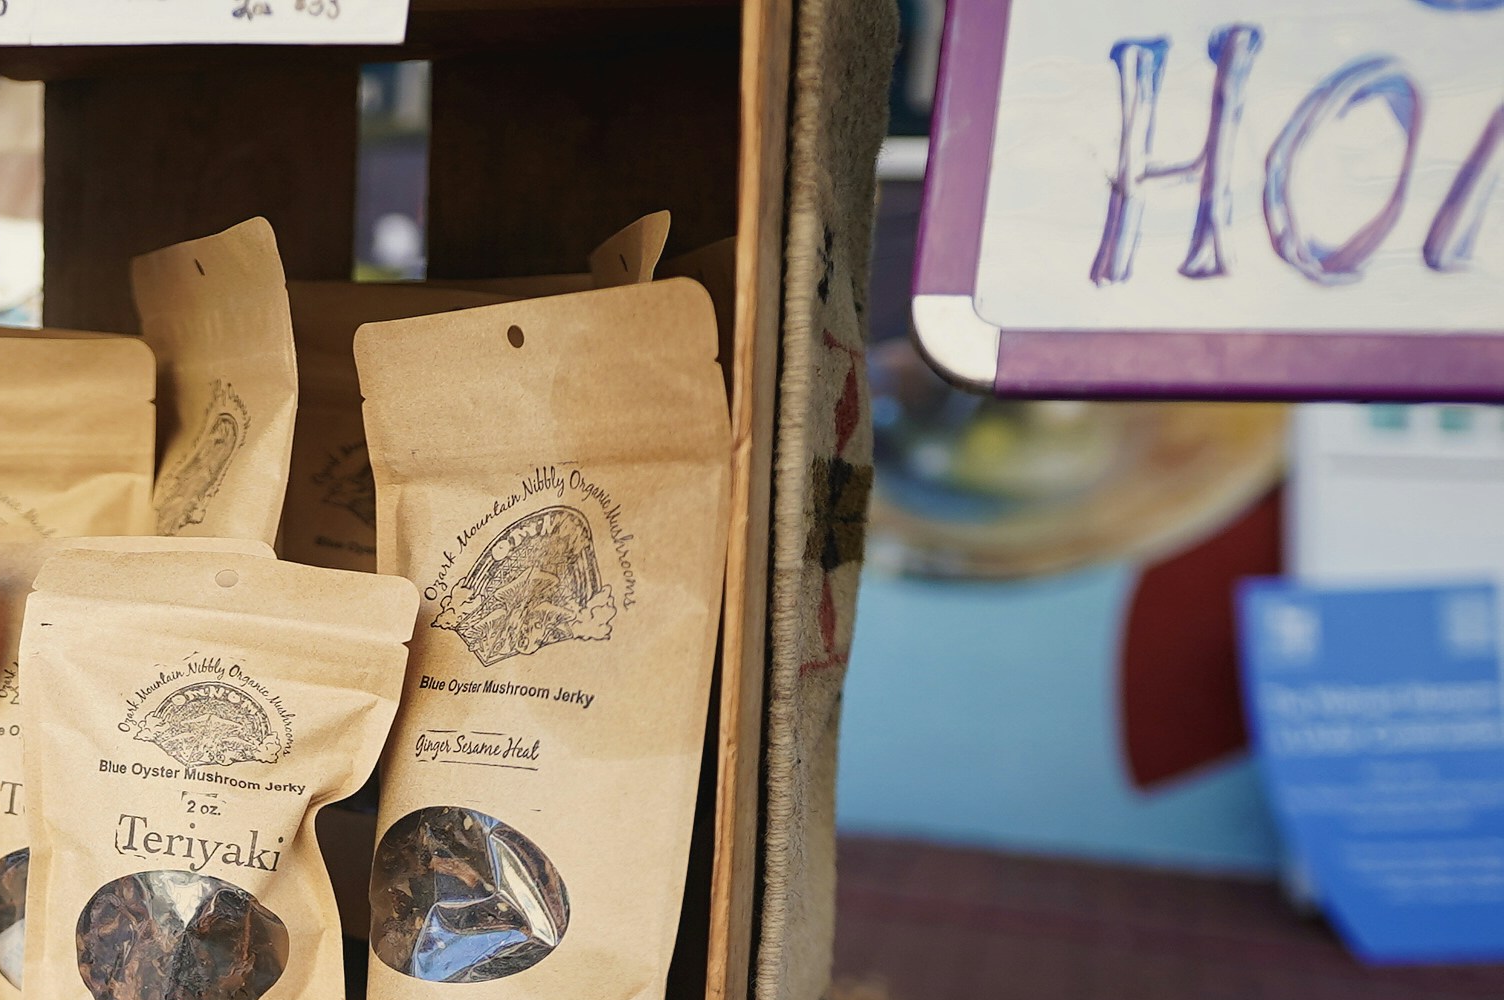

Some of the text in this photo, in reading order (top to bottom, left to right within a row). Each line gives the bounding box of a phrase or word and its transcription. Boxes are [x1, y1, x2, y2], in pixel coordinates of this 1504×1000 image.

[423, 465, 637, 611] Ozark Mountain Nibbly Organic Mushrooms
[117, 657, 296, 757] Ozark Mountain Nibbly Organic Mushrooms
[419, 675, 595, 710] Blue Oyster Mushroom Jerky
[415, 734, 540, 761] Ginger Sesame Heat
[99, 760, 306, 795] Blue Oyster Mushroom Jerky
[186, 800, 221, 816] 2 oz.
[118, 813, 284, 872] Teriyaki
